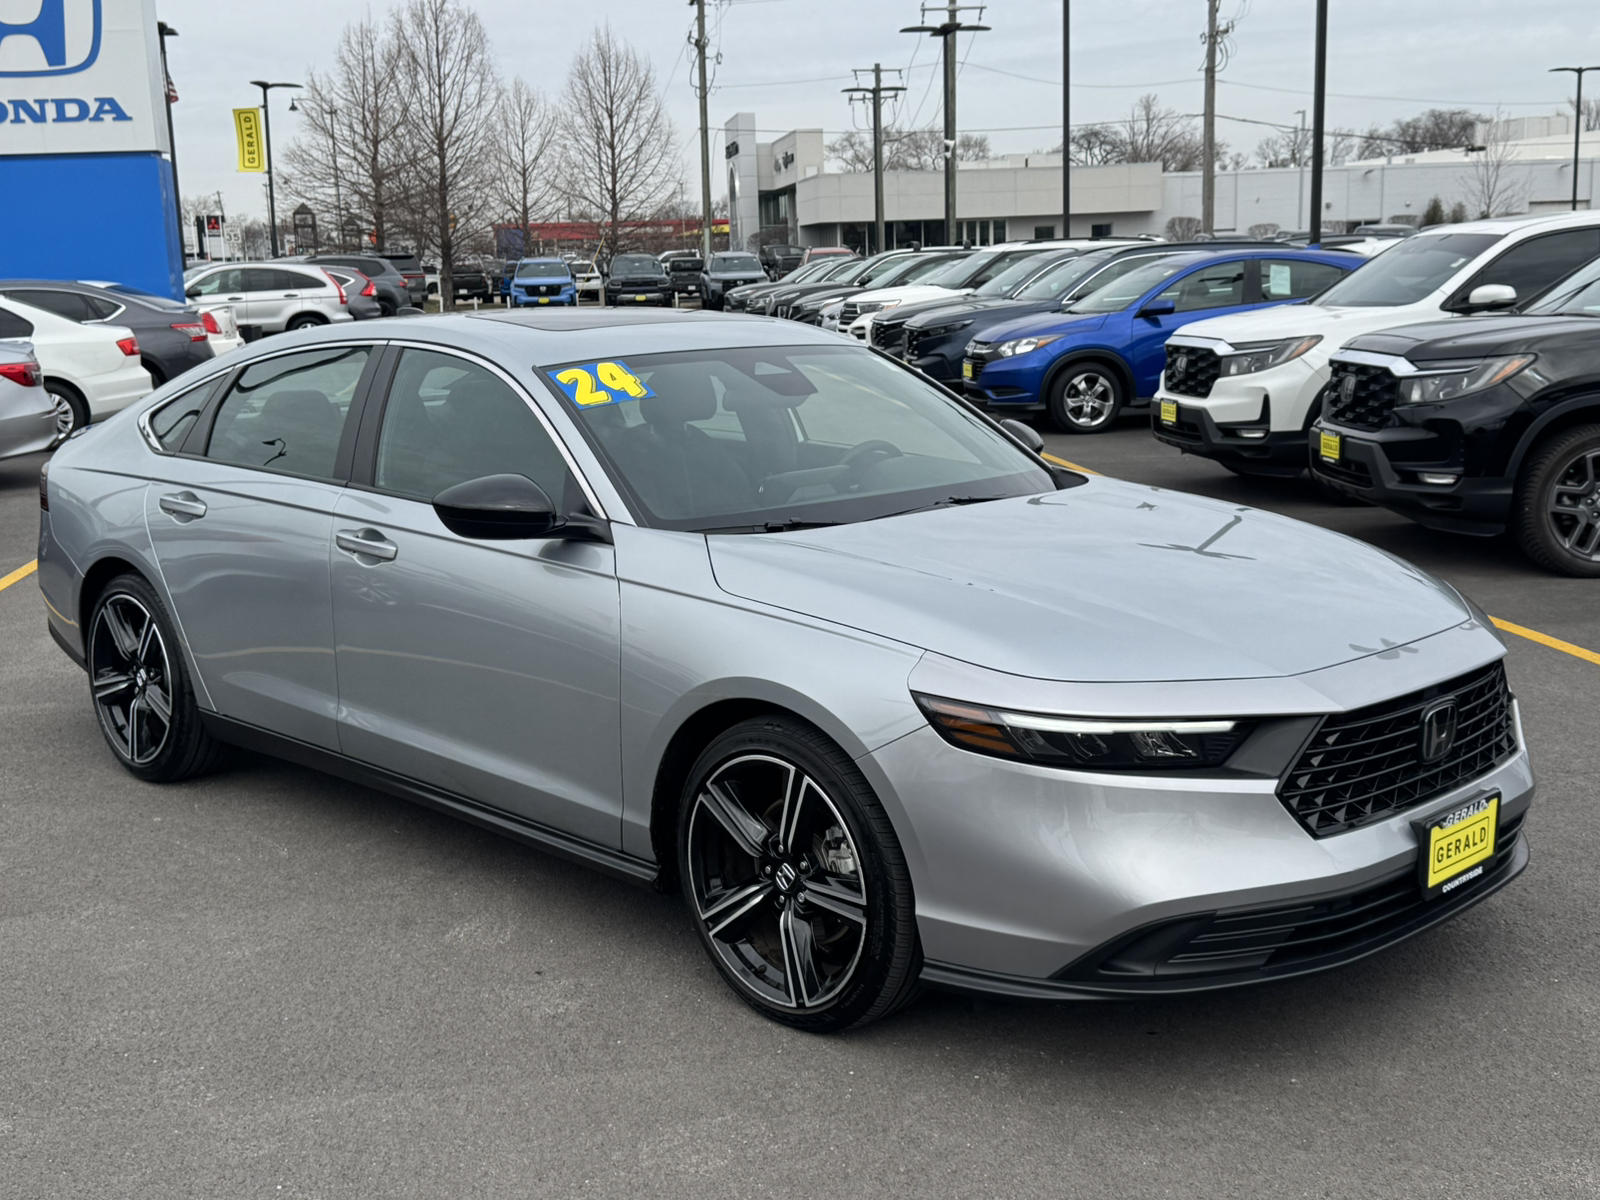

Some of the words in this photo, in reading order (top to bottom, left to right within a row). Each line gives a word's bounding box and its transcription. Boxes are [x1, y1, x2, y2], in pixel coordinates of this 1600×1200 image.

[243, 116, 256, 164] GERALD
[226, 233, 240, 241] 35
[555, 362, 648, 406] 24
[1444, 799, 1488, 827] GERALD
[1436, 827, 1487, 863] GERALD
[1442, 866, 1483, 893] COUNTRYSIDE
